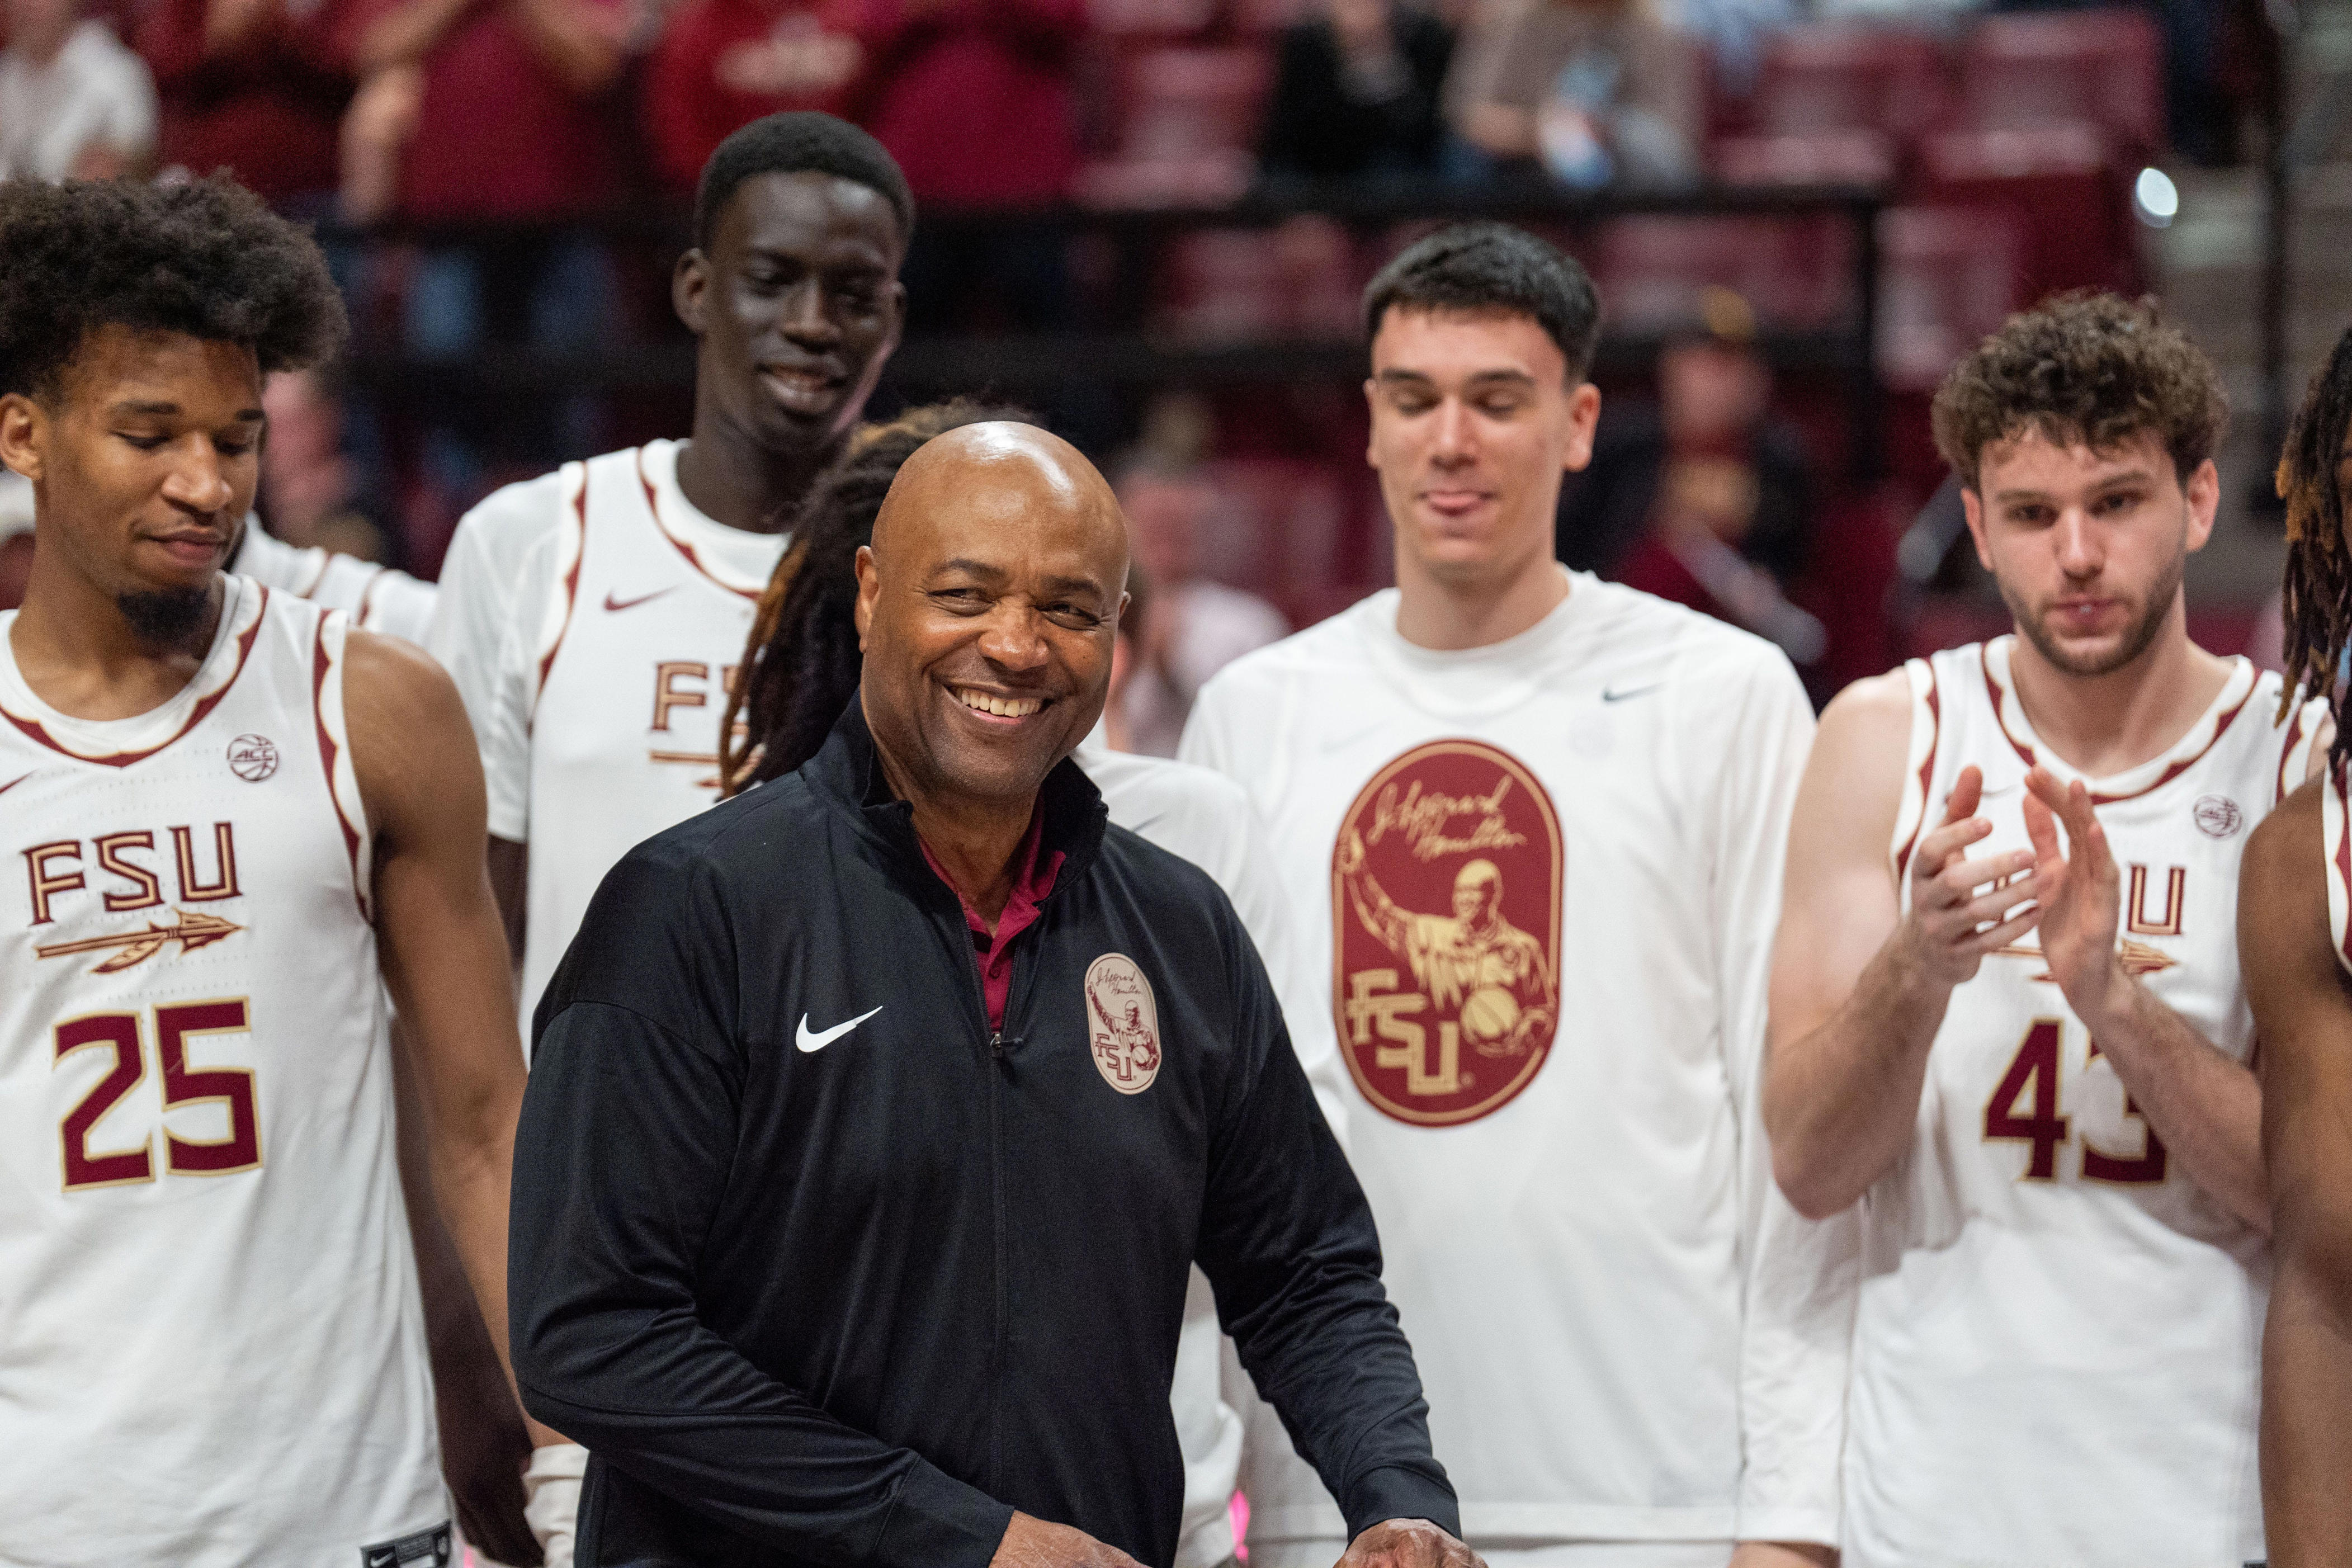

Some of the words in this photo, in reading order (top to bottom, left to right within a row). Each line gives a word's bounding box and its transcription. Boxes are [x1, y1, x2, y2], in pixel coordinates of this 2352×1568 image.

[21, 821, 243, 925] FSU
[1094, 1032, 1132, 1081] FSU
[1344, 967, 1460, 1096] FSU
[52, 996, 263, 1192] 25
